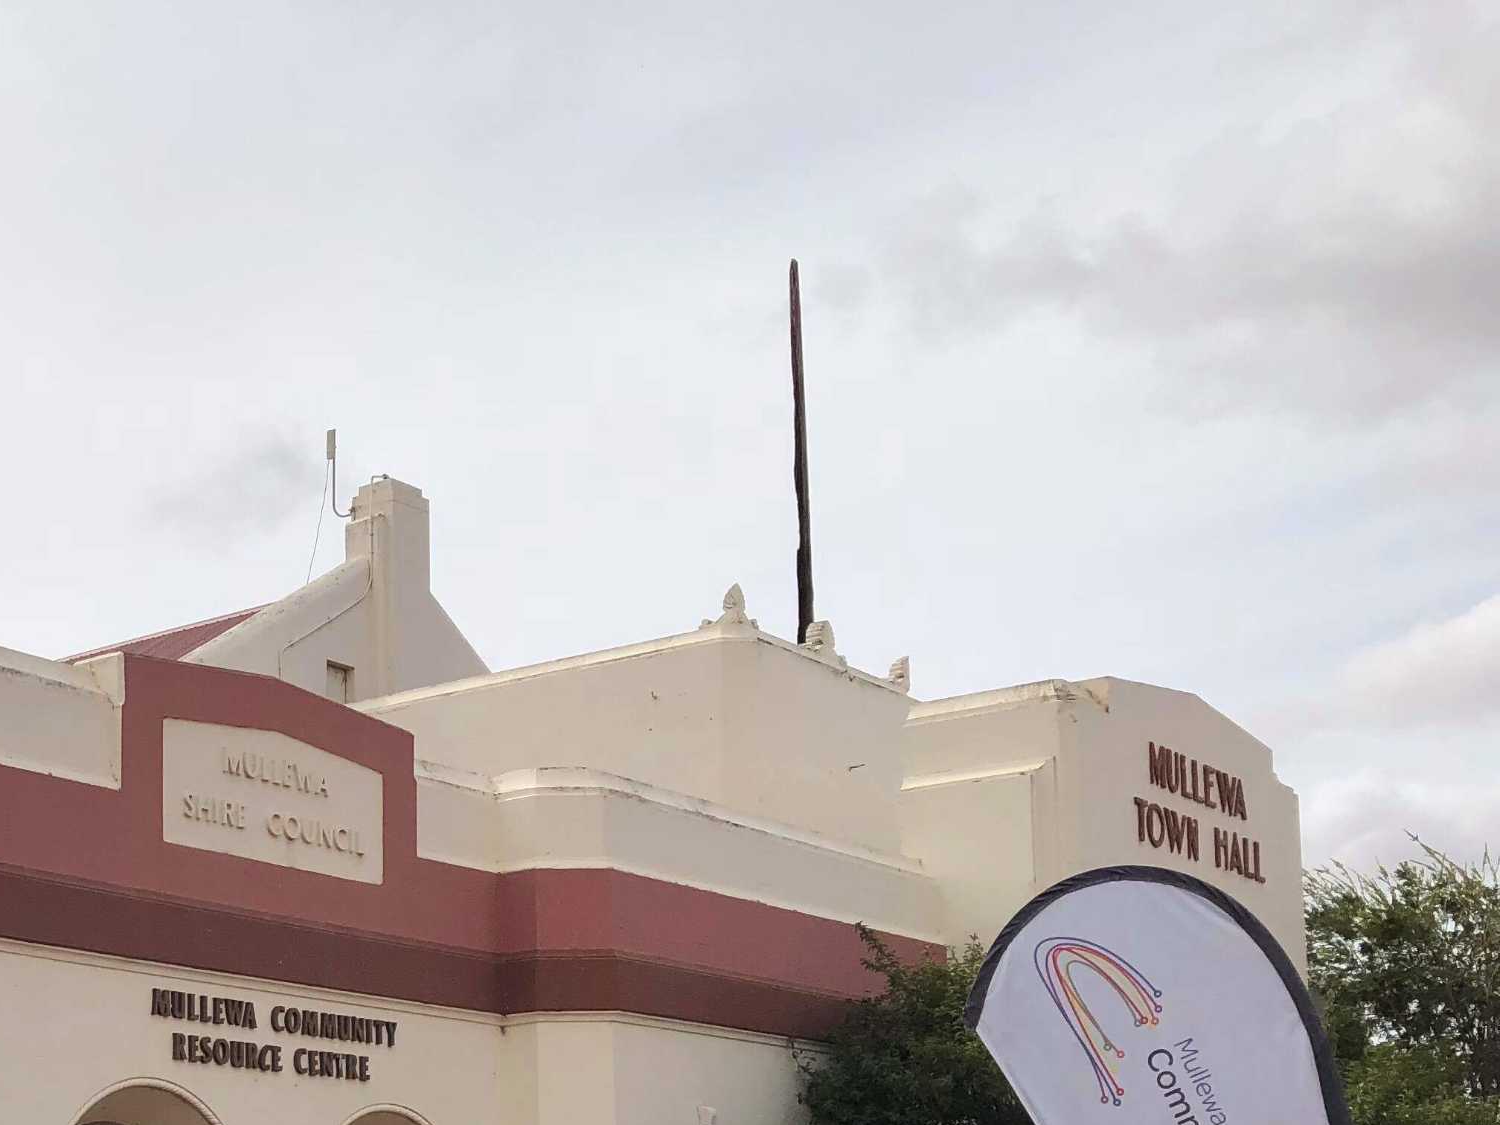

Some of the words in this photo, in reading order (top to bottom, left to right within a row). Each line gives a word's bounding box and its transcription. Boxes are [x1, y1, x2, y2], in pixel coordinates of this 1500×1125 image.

[221, 747, 329, 798] MULLEWA
[1149, 741, 1247, 820] MULLEWA
[182, 795, 246, 829] SHIRE
[266, 813, 365, 856] COUNCIL
[1133, 796, 1200, 862] TOWN
[1213, 827, 1266, 883] HALL
[150, 987, 258, 1029] MULLEWA
[270, 1005, 398, 1048] COMMUNITY
[171, 1032, 283, 1072] RESOURCE
[293, 1048, 371, 1081] CENTRE
